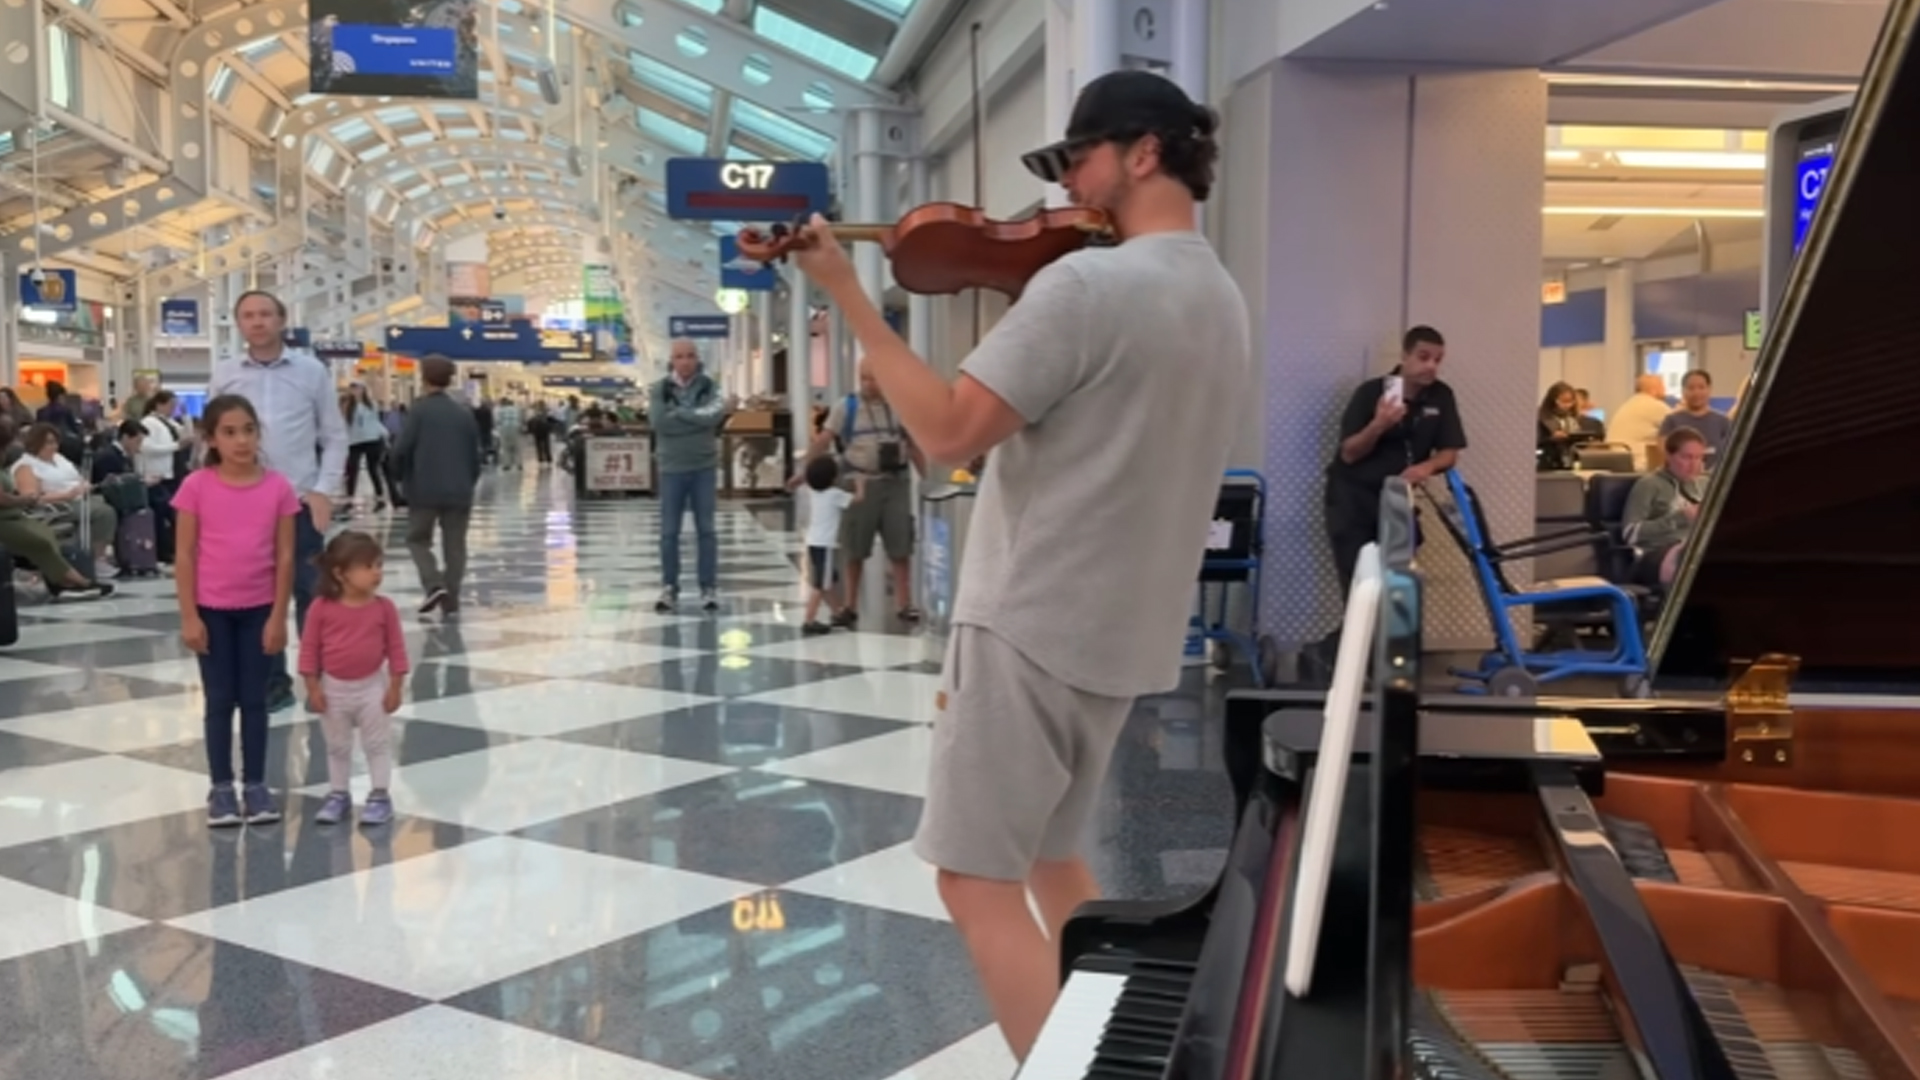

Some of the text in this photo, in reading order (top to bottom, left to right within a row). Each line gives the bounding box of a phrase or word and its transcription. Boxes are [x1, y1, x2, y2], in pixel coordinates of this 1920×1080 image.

[410, 59, 452, 68] UNITED
[720, 163, 775, 189] C17
[604, 453, 633, 473] #1
[594, 476, 616, 485] HOT
